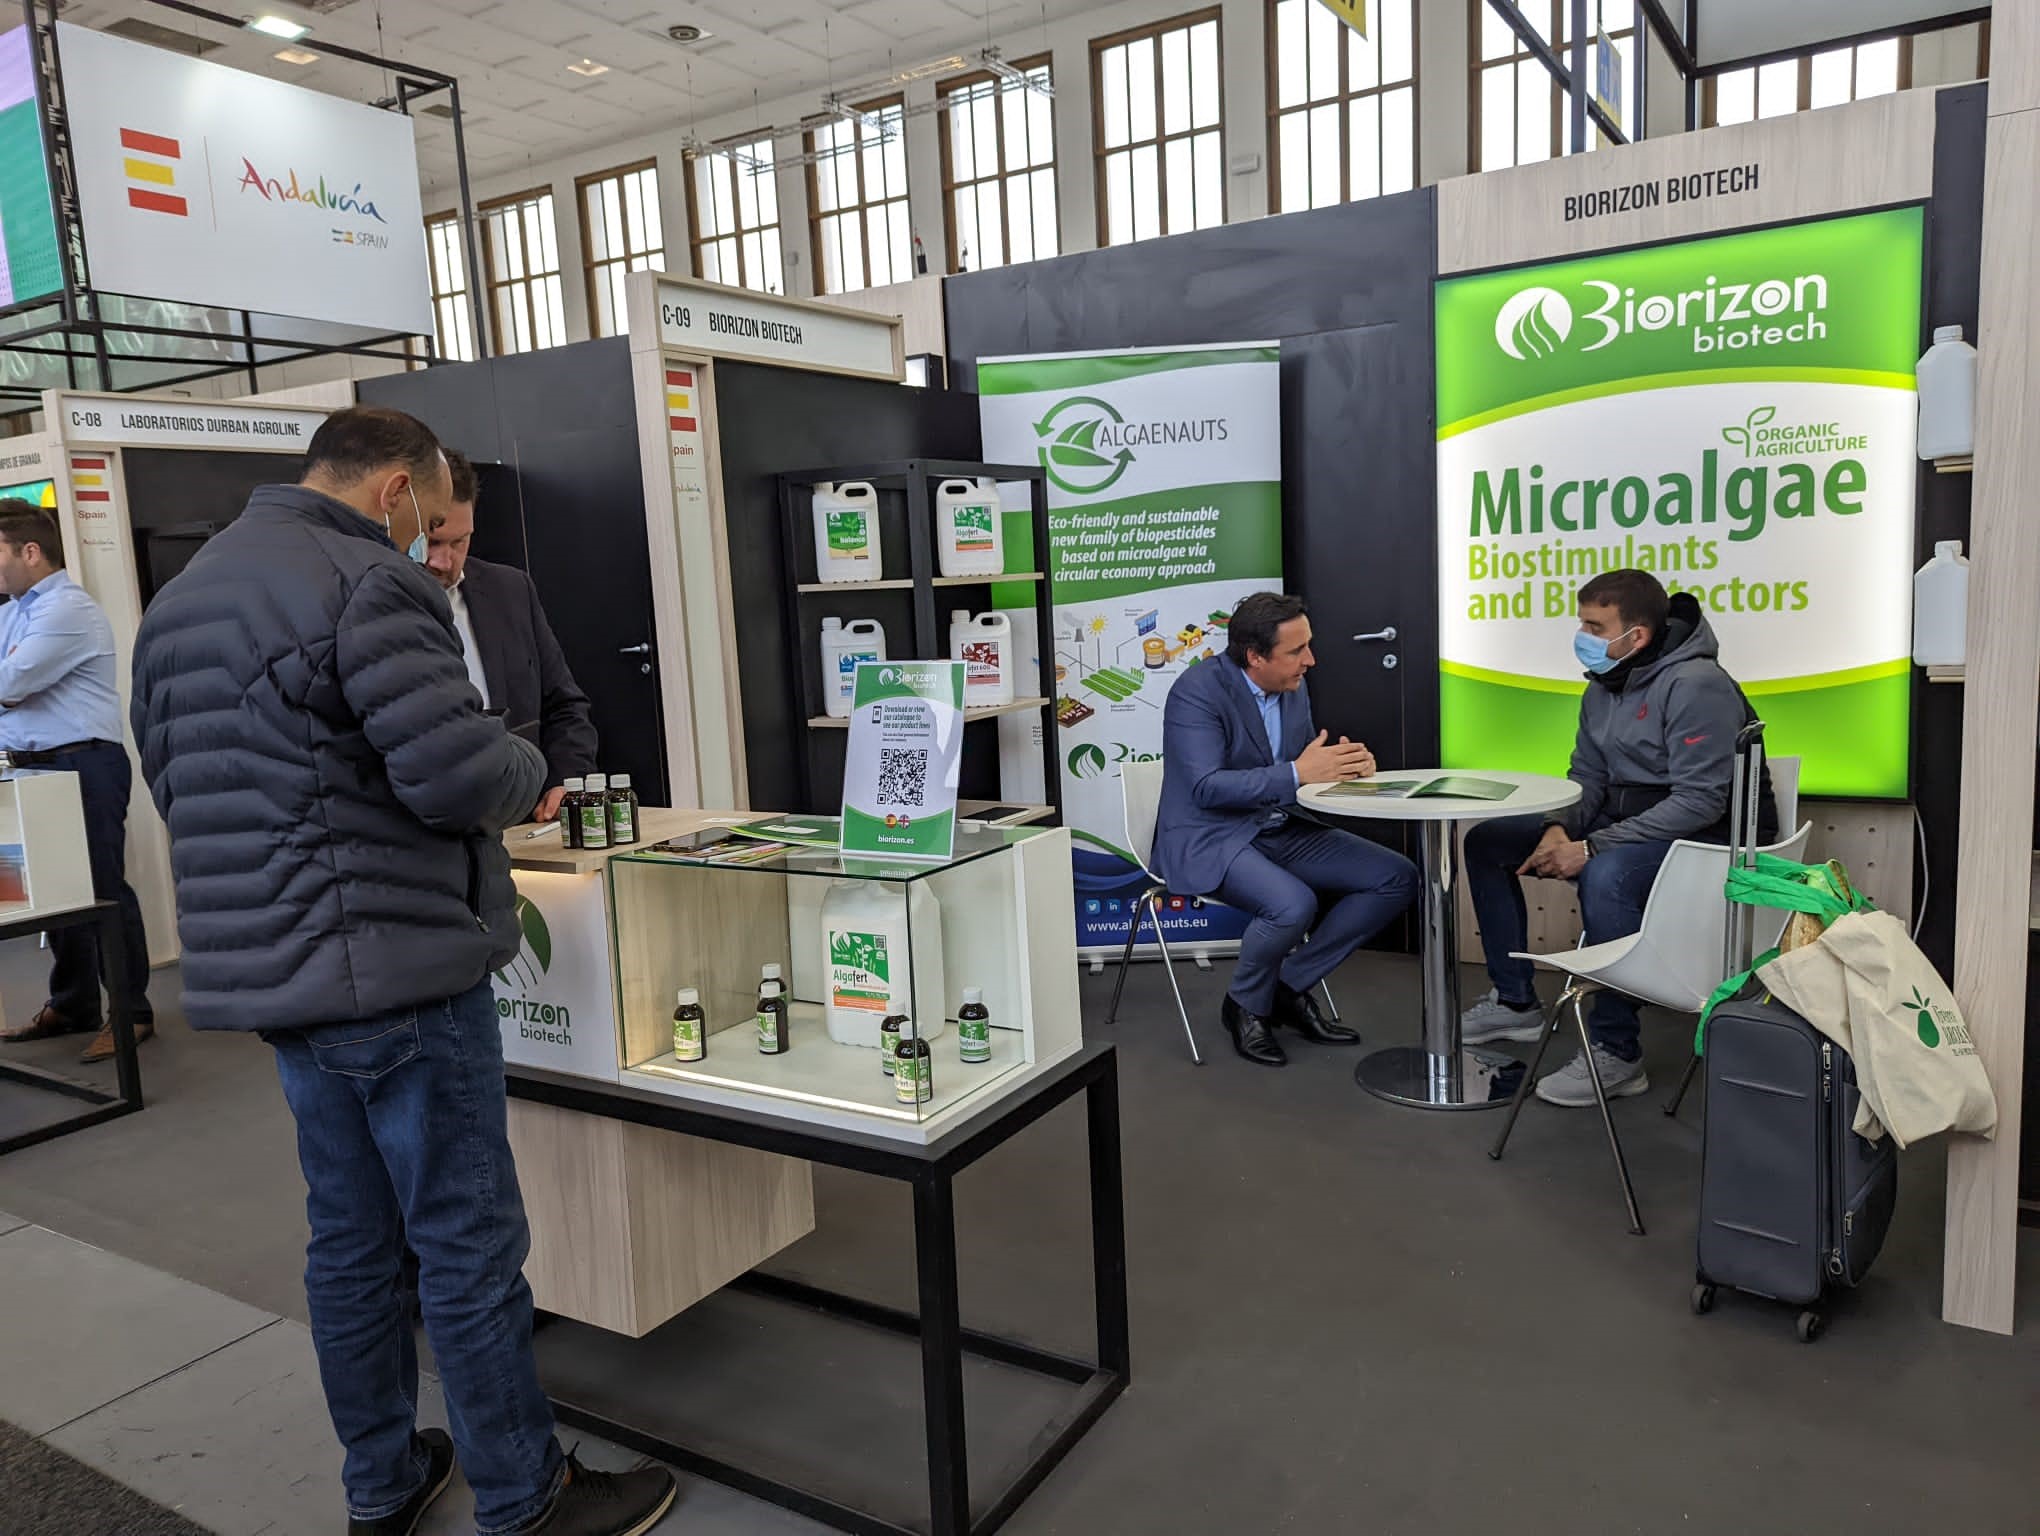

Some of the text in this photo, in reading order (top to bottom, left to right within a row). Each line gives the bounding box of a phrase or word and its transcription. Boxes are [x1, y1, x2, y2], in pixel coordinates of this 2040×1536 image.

[238, 156, 388, 224] Andalucía
[1564, 163, 1759, 222] BIORIZON BIOTECH
[356, 232, 389, 249] SPAIN
[663, 304, 803, 345] C-09 BIORIZON BIOTECH
[1581, 274, 1827, 352] Biorizon
[1694, 312, 1826, 353] biotech
[72, 411, 301, 437] C-08 LABORATORIOS DURBAN AGROLINE
[1100, 418, 1228, 447] ALGAENAUTS
[1756, 422, 1840, 441] ORGANIC
[672, 443, 694, 457] pain
[1756, 435, 1868, 457] AGRICULTURE
[1469, 448, 1868, 542] Microalgae
[78, 510, 106, 520] Spain
[1049, 506, 1220, 530] Eco-friendly and sustainable
[1052, 525, 1217, 547] new family of biopesticides
[1061, 543, 1207, 564] based on microalgae via
[1468, 534, 1719, 581] Biostimulants
[1054, 560, 1216, 582] circular economy approach
[1467, 577, 1809, 621] and Bictors
[878, 834, 915, 845] biorizon.es
[1087, 918, 1208, 933] www.alaeauts.eu
[496, 993, 570, 1028] orizon
[520, 1021, 572, 1046] biotech
